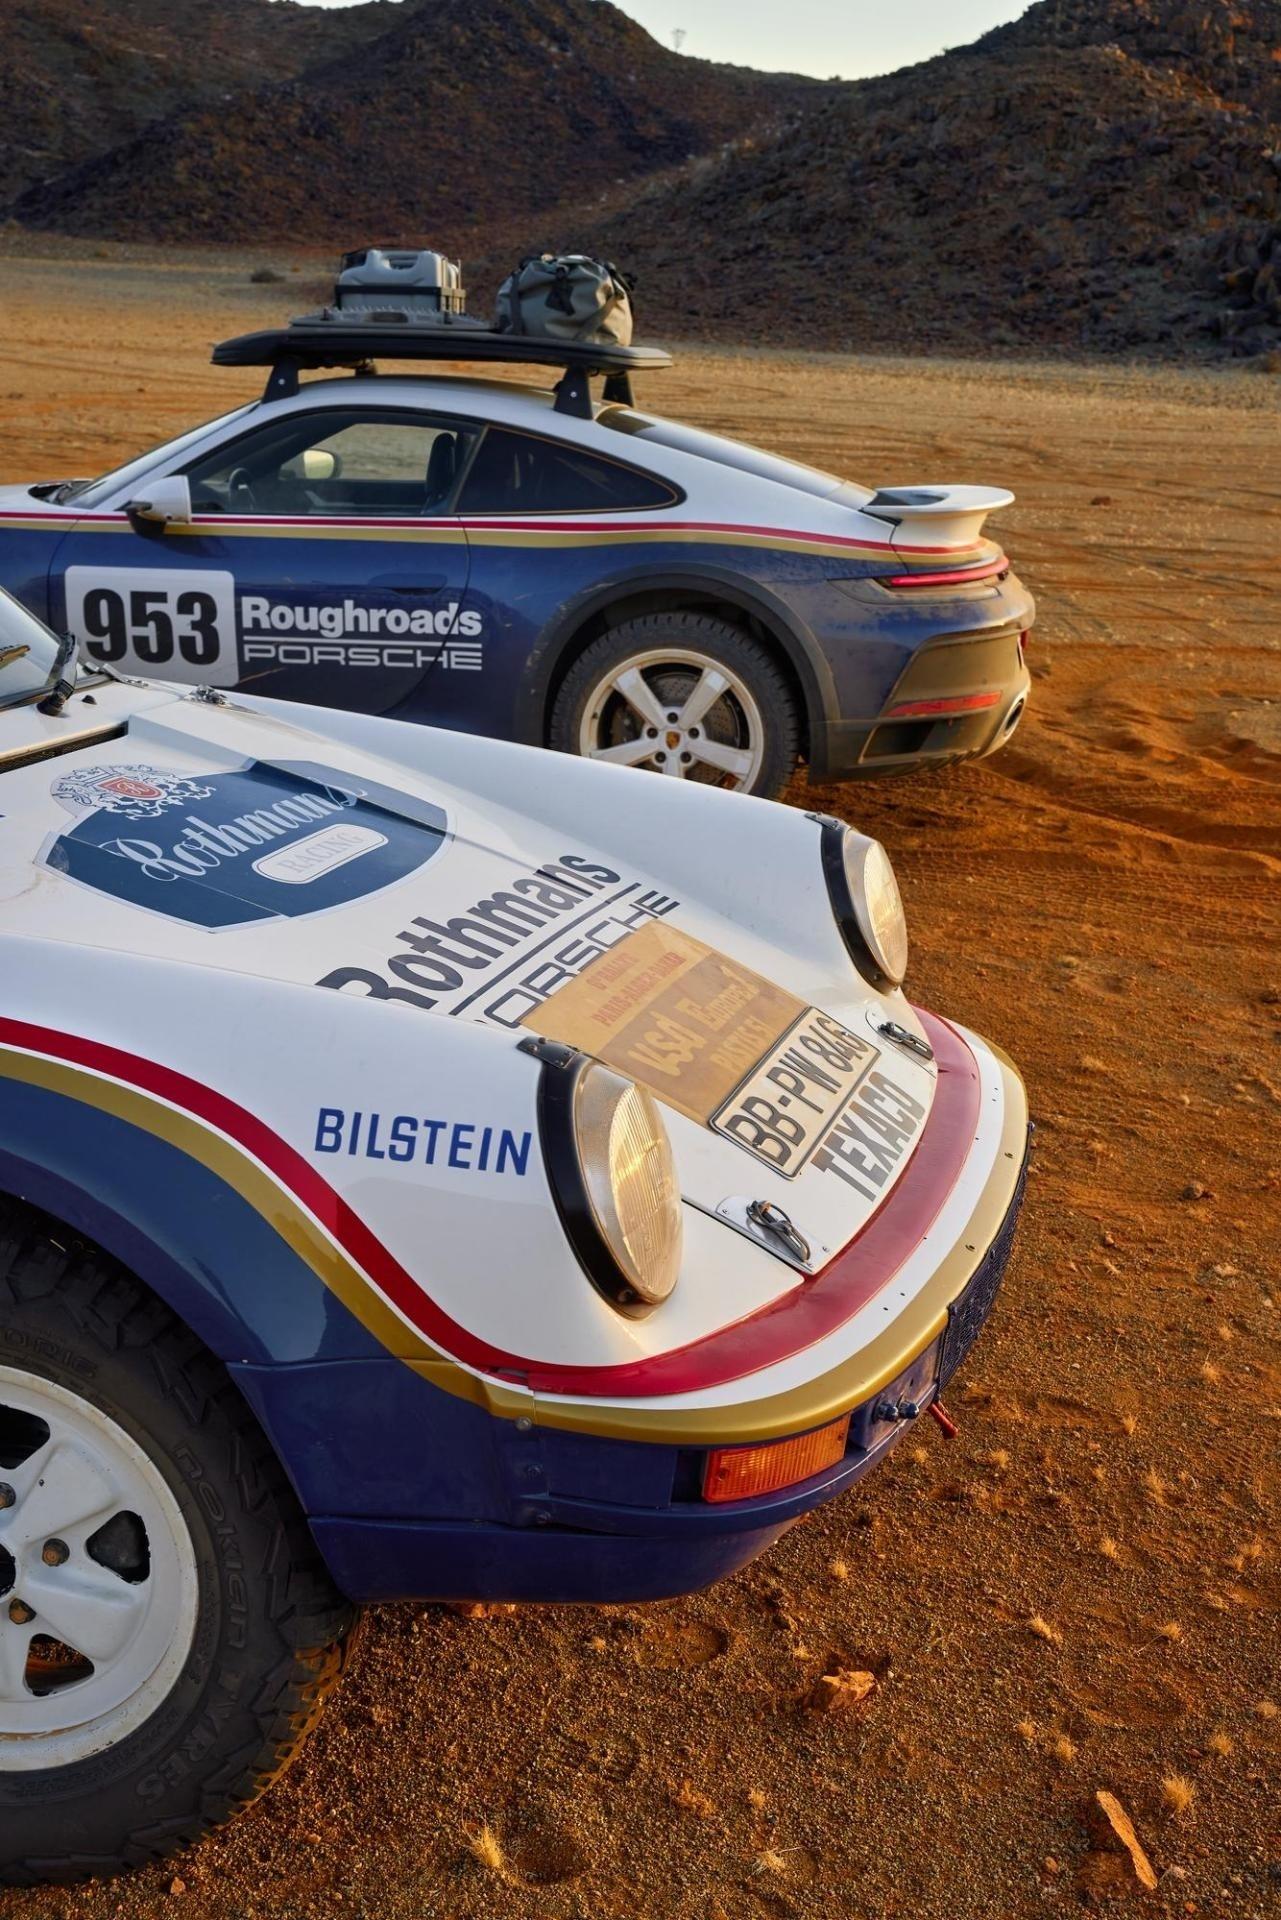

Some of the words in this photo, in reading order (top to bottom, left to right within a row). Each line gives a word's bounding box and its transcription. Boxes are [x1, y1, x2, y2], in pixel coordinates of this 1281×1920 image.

[83, 588, 222, 665] 953
[242, 596, 483, 638] Roughroads
[243, 643, 483, 671] PORSCHE
[276, 831, 364, 873] RACING
[314, 855, 621, 1010] Rothmans
[474, 890, 680, 1029] ORSCHE
[724, 1047, 842, 1167] BB-PW
[799, 1016, 869, 1073] 846
[314, 1107, 532, 1176] BILSTEIN
[810, 1071, 926, 1202] TEXACO
